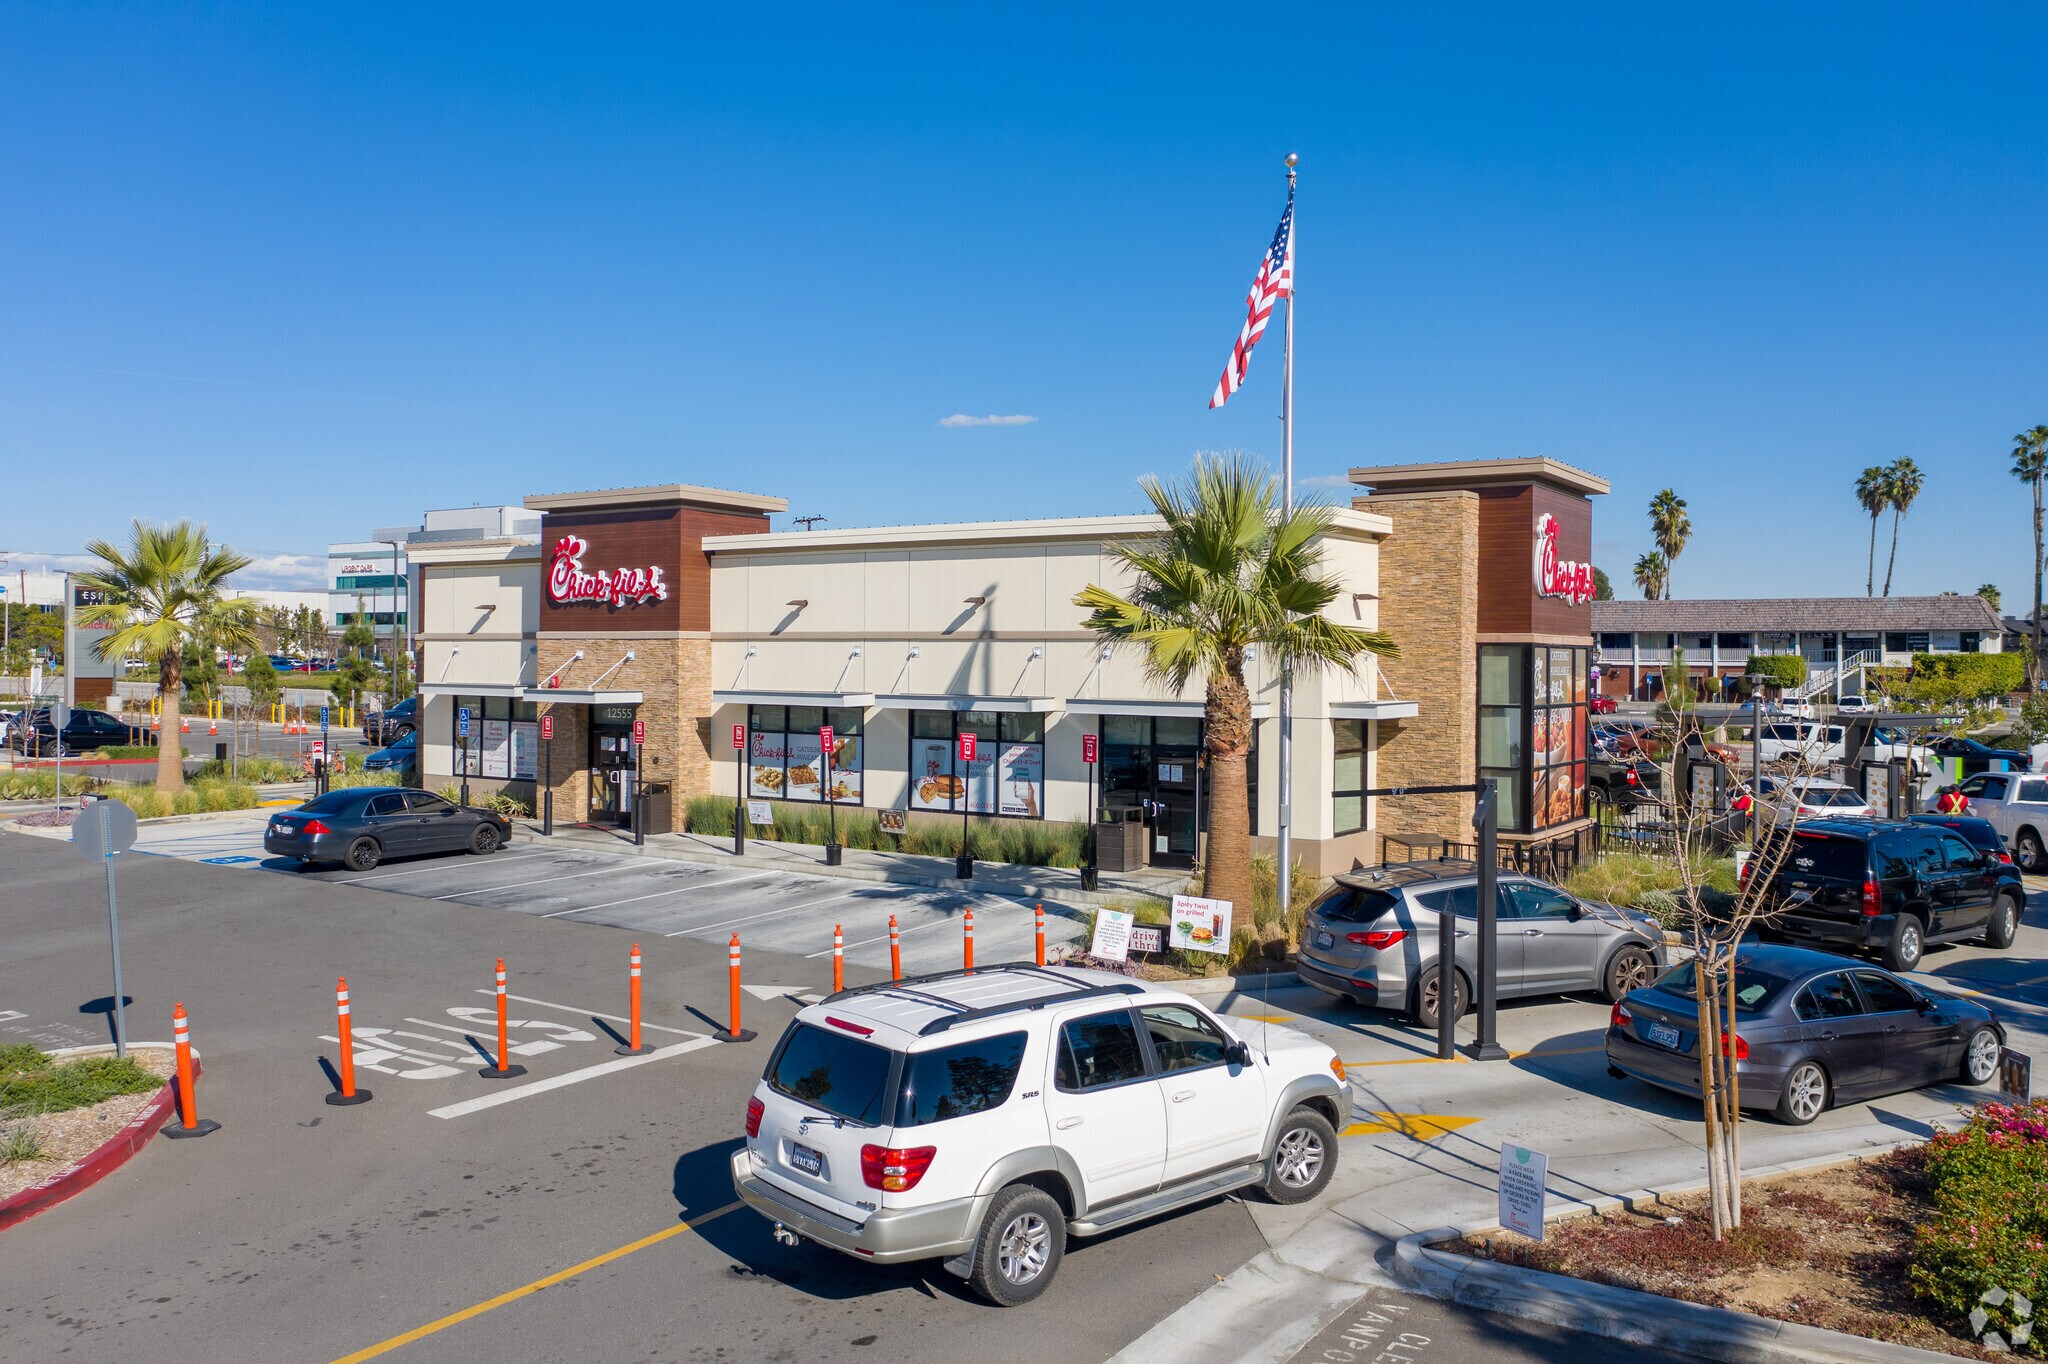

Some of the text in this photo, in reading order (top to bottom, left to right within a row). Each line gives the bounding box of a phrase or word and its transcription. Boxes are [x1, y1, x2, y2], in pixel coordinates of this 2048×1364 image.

[1541, 515, 1597, 604] Chick-fil-A
[548, 537, 663, 606] Chick-fil-A
[607, 708, 632, 718] 12555
[1176, 900, 1209, 910] Spicy twist
[1186, 909, 1204, 917] grilled
[1132, 930, 1160, 942] drive
[1135, 941, 1158, 951] thru
[1509, 1162, 1535, 1174] PLEASE WEAR
[1501, 1181, 1515, 1189] PAYING
[1524, 1189, 1540, 1197] PICKING
[1509, 1190, 1524, 1199] ORDERS
[1530, 1196, 1538, 1204] THE
[1312, 1304, 1410, 1364] VANPO
